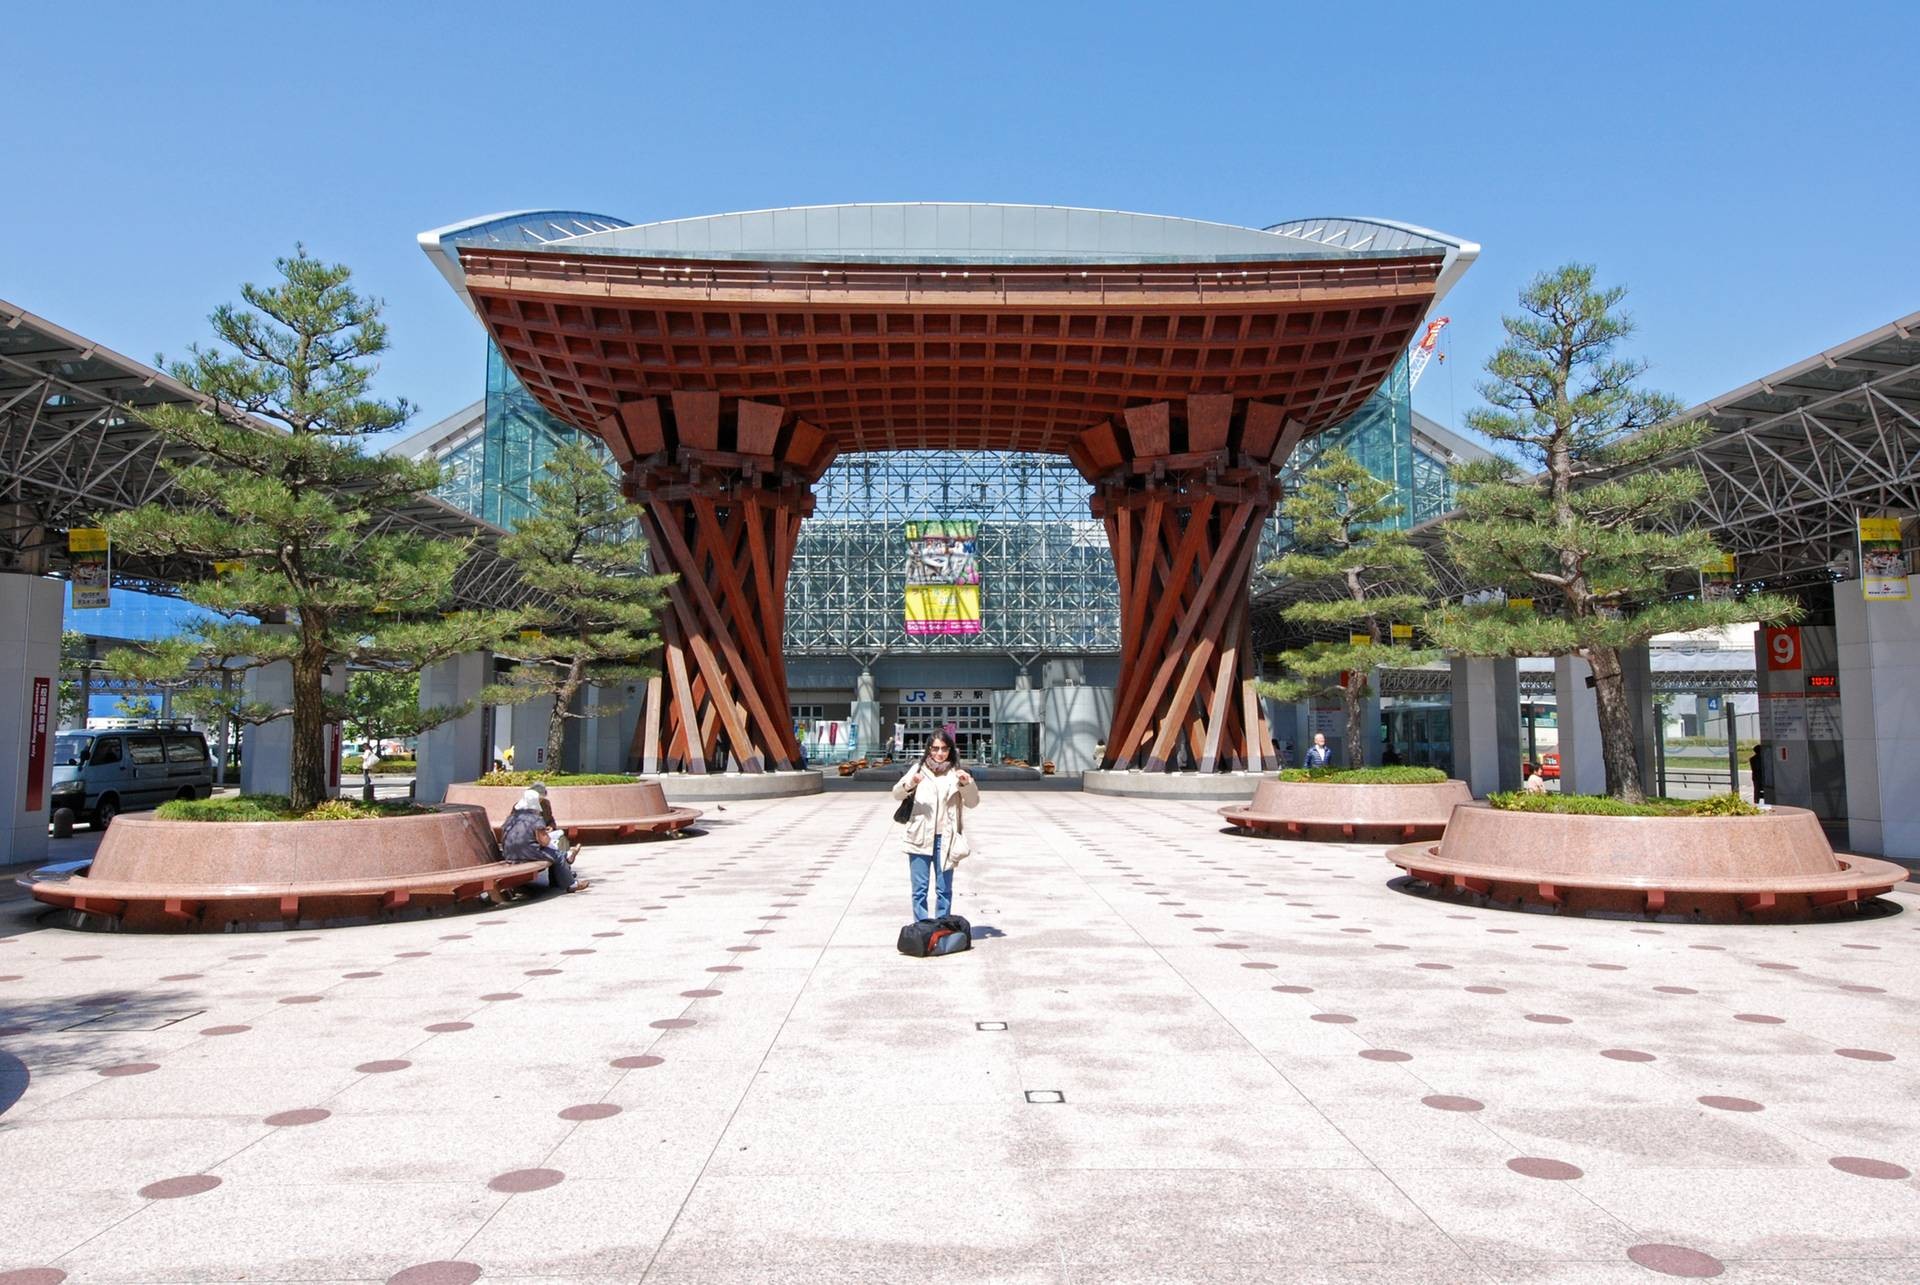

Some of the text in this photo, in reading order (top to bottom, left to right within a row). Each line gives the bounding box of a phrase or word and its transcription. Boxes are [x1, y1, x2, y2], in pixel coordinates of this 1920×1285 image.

[1773, 634, 1794, 664] 9
[906, 690, 926, 702] JR
[933, 690, 984, 700] 金沢駅
